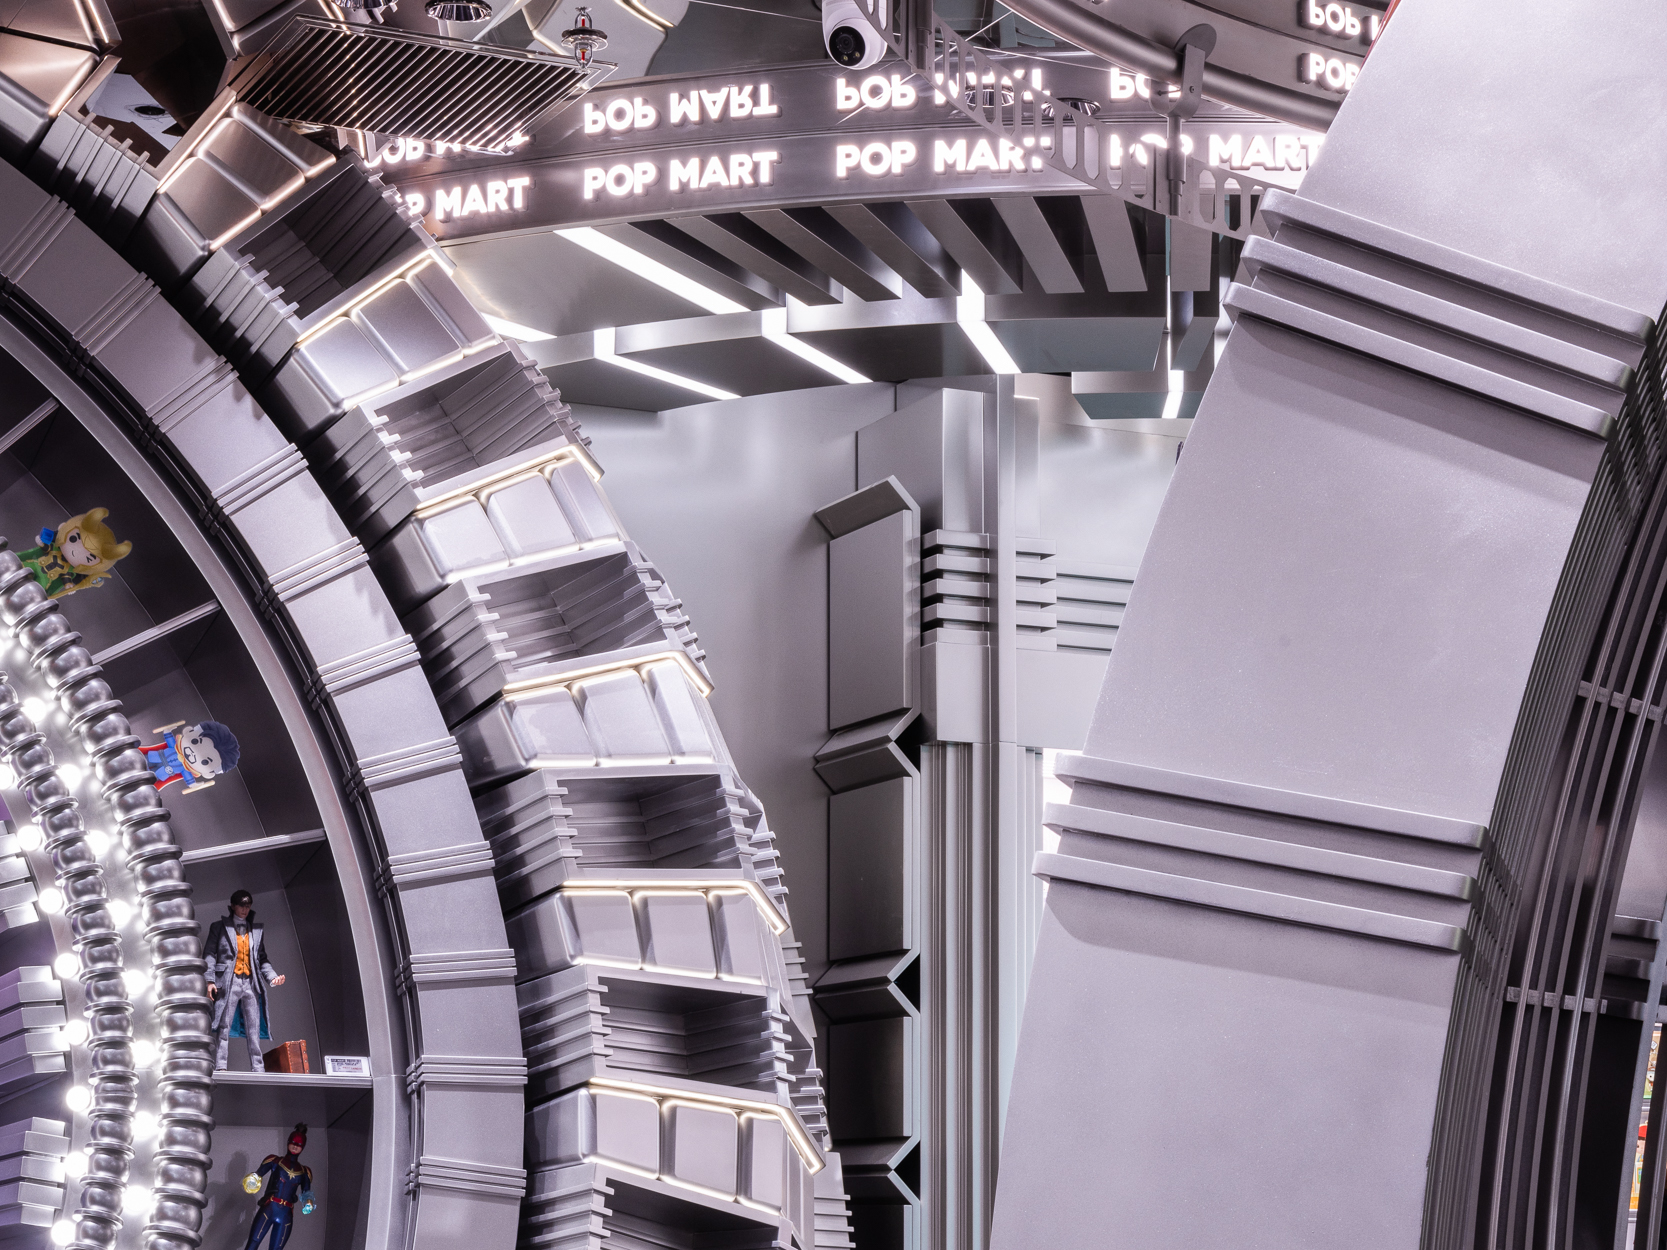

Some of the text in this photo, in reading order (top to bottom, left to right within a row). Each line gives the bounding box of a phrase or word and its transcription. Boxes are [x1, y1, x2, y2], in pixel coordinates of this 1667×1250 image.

[1309, 52, 1360, 90] POP
[584, 151, 778, 199] POP MART
[836, 141, 916, 177] POP
[435, 177, 529, 219] MART
